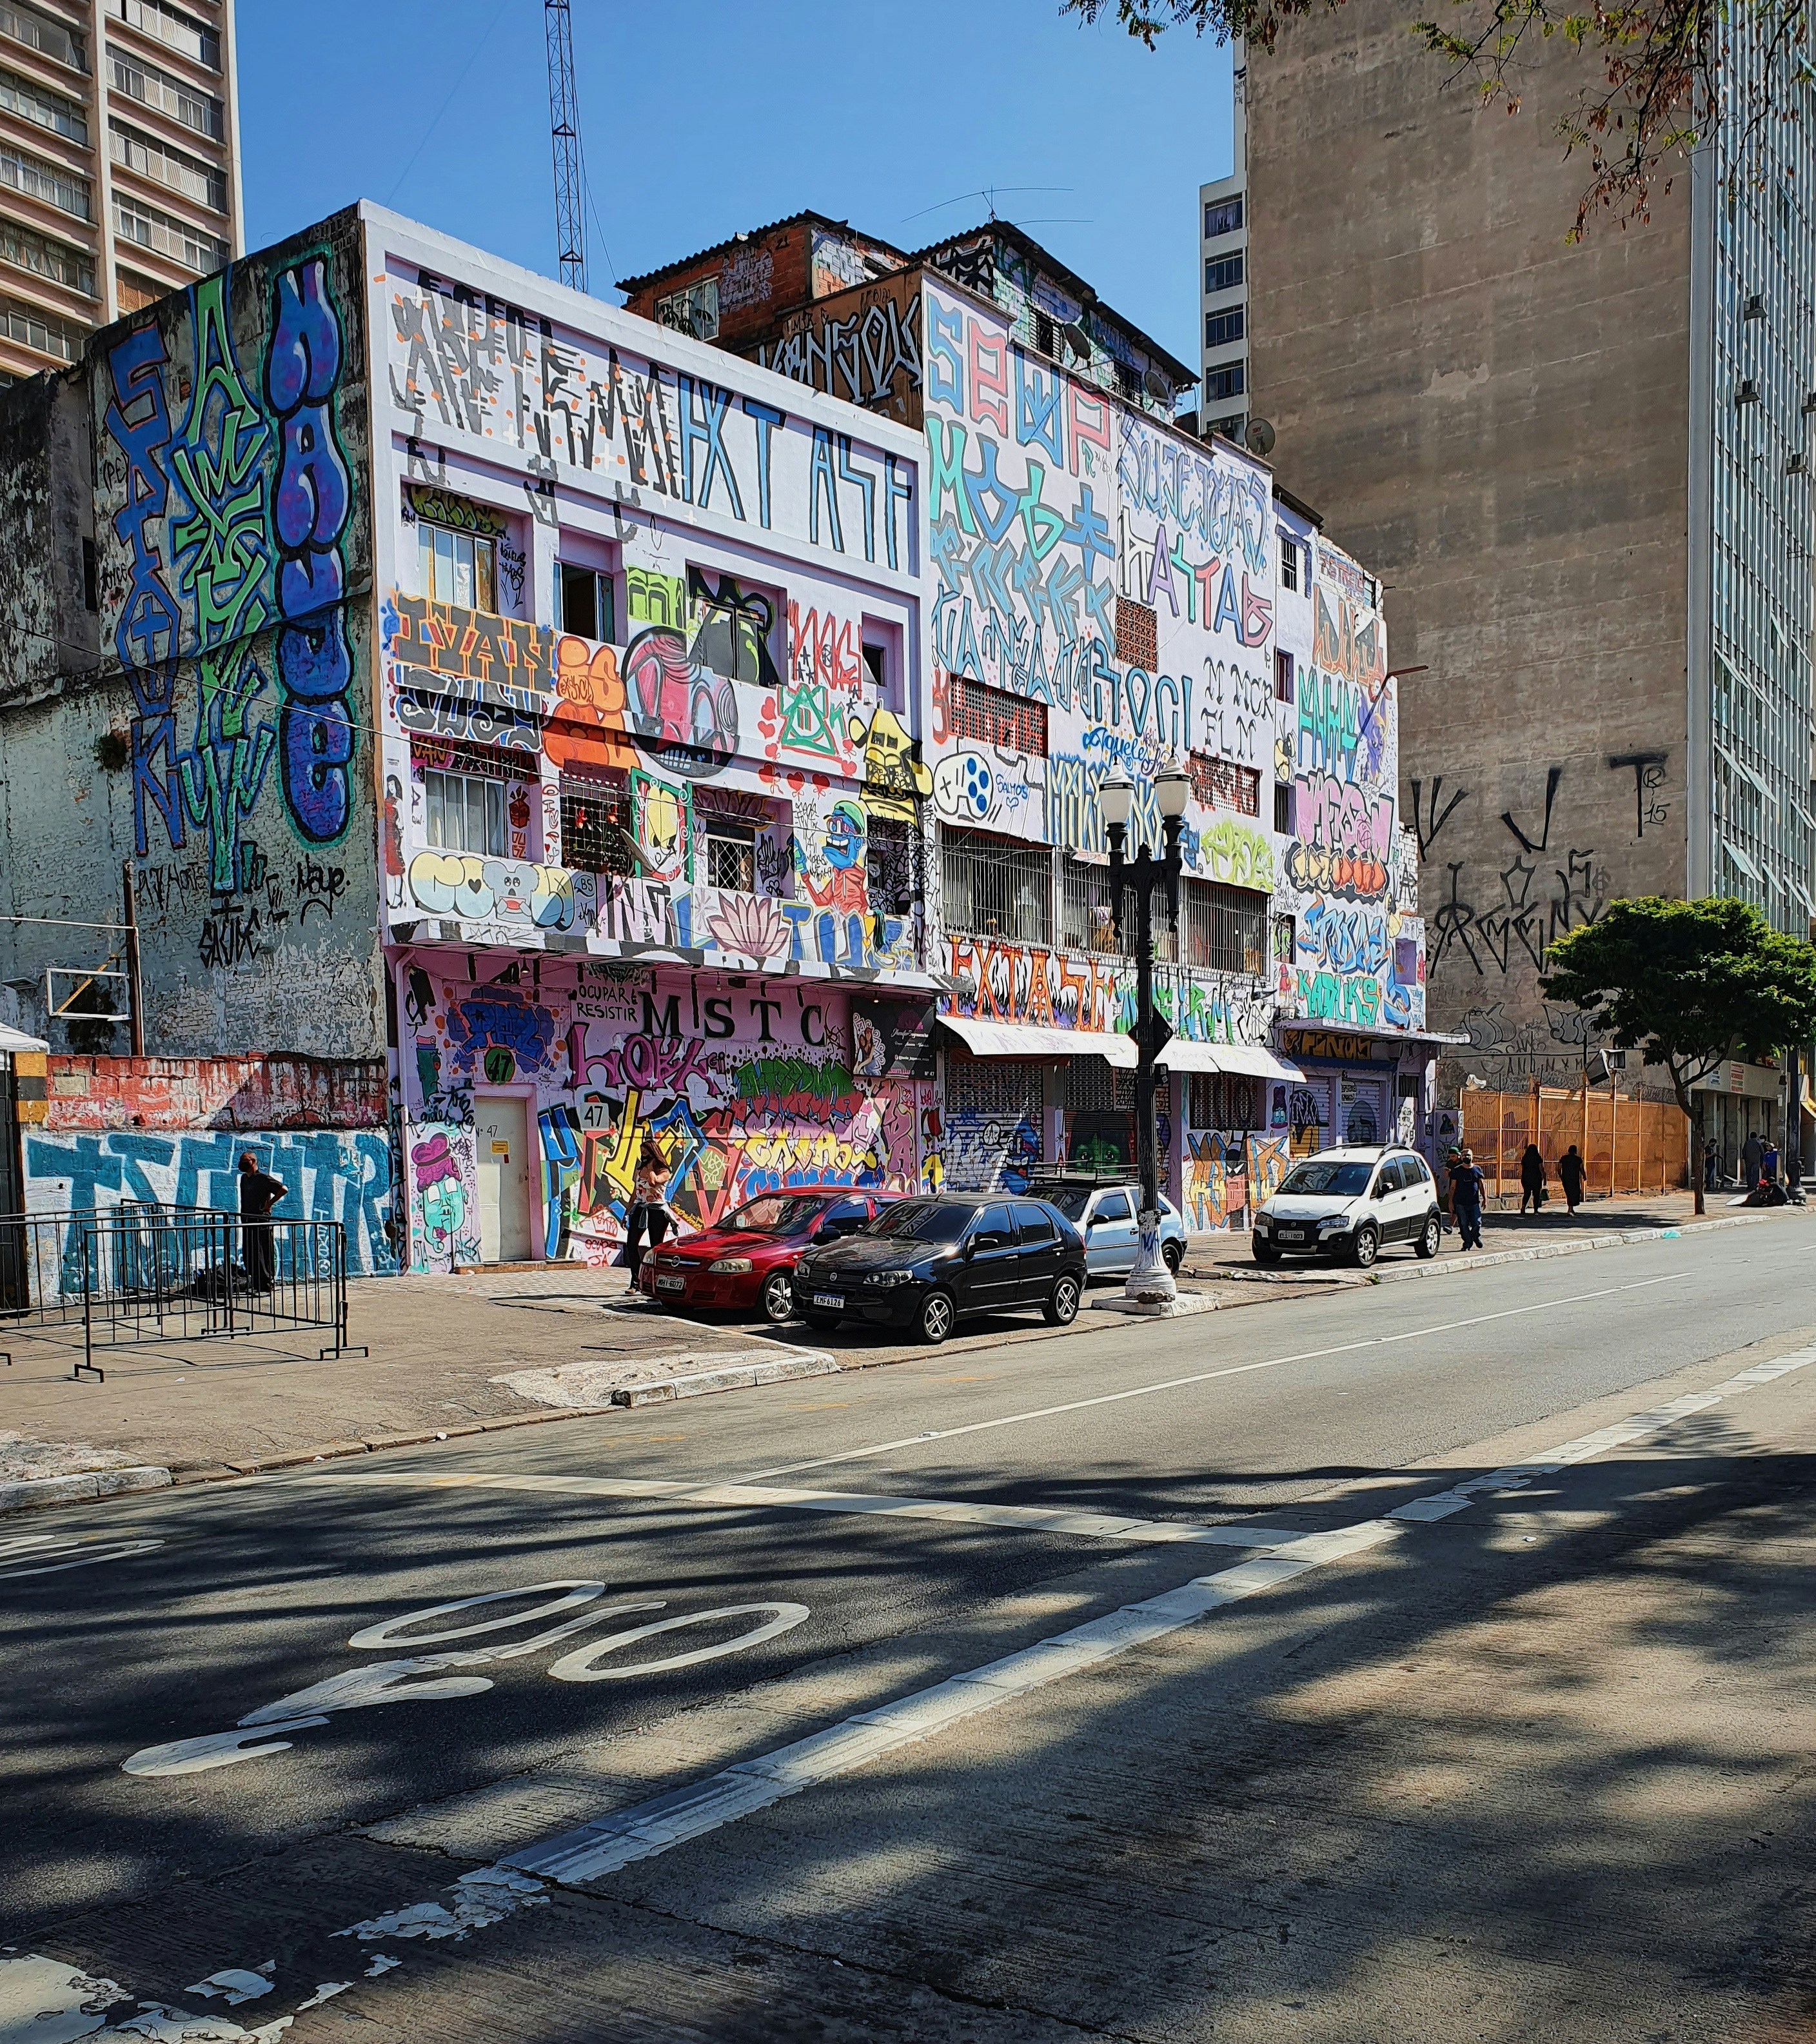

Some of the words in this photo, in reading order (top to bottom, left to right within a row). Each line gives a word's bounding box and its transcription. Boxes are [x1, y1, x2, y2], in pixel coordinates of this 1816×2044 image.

[578, 985, 630, 1006] OCUPAR
[577, 1002, 637, 1022] RESISTIR
[487, 1053, 511, 1082] 47
[584, 1106, 602, 1127] 47
[487, 1126, 498, 1138] 47
